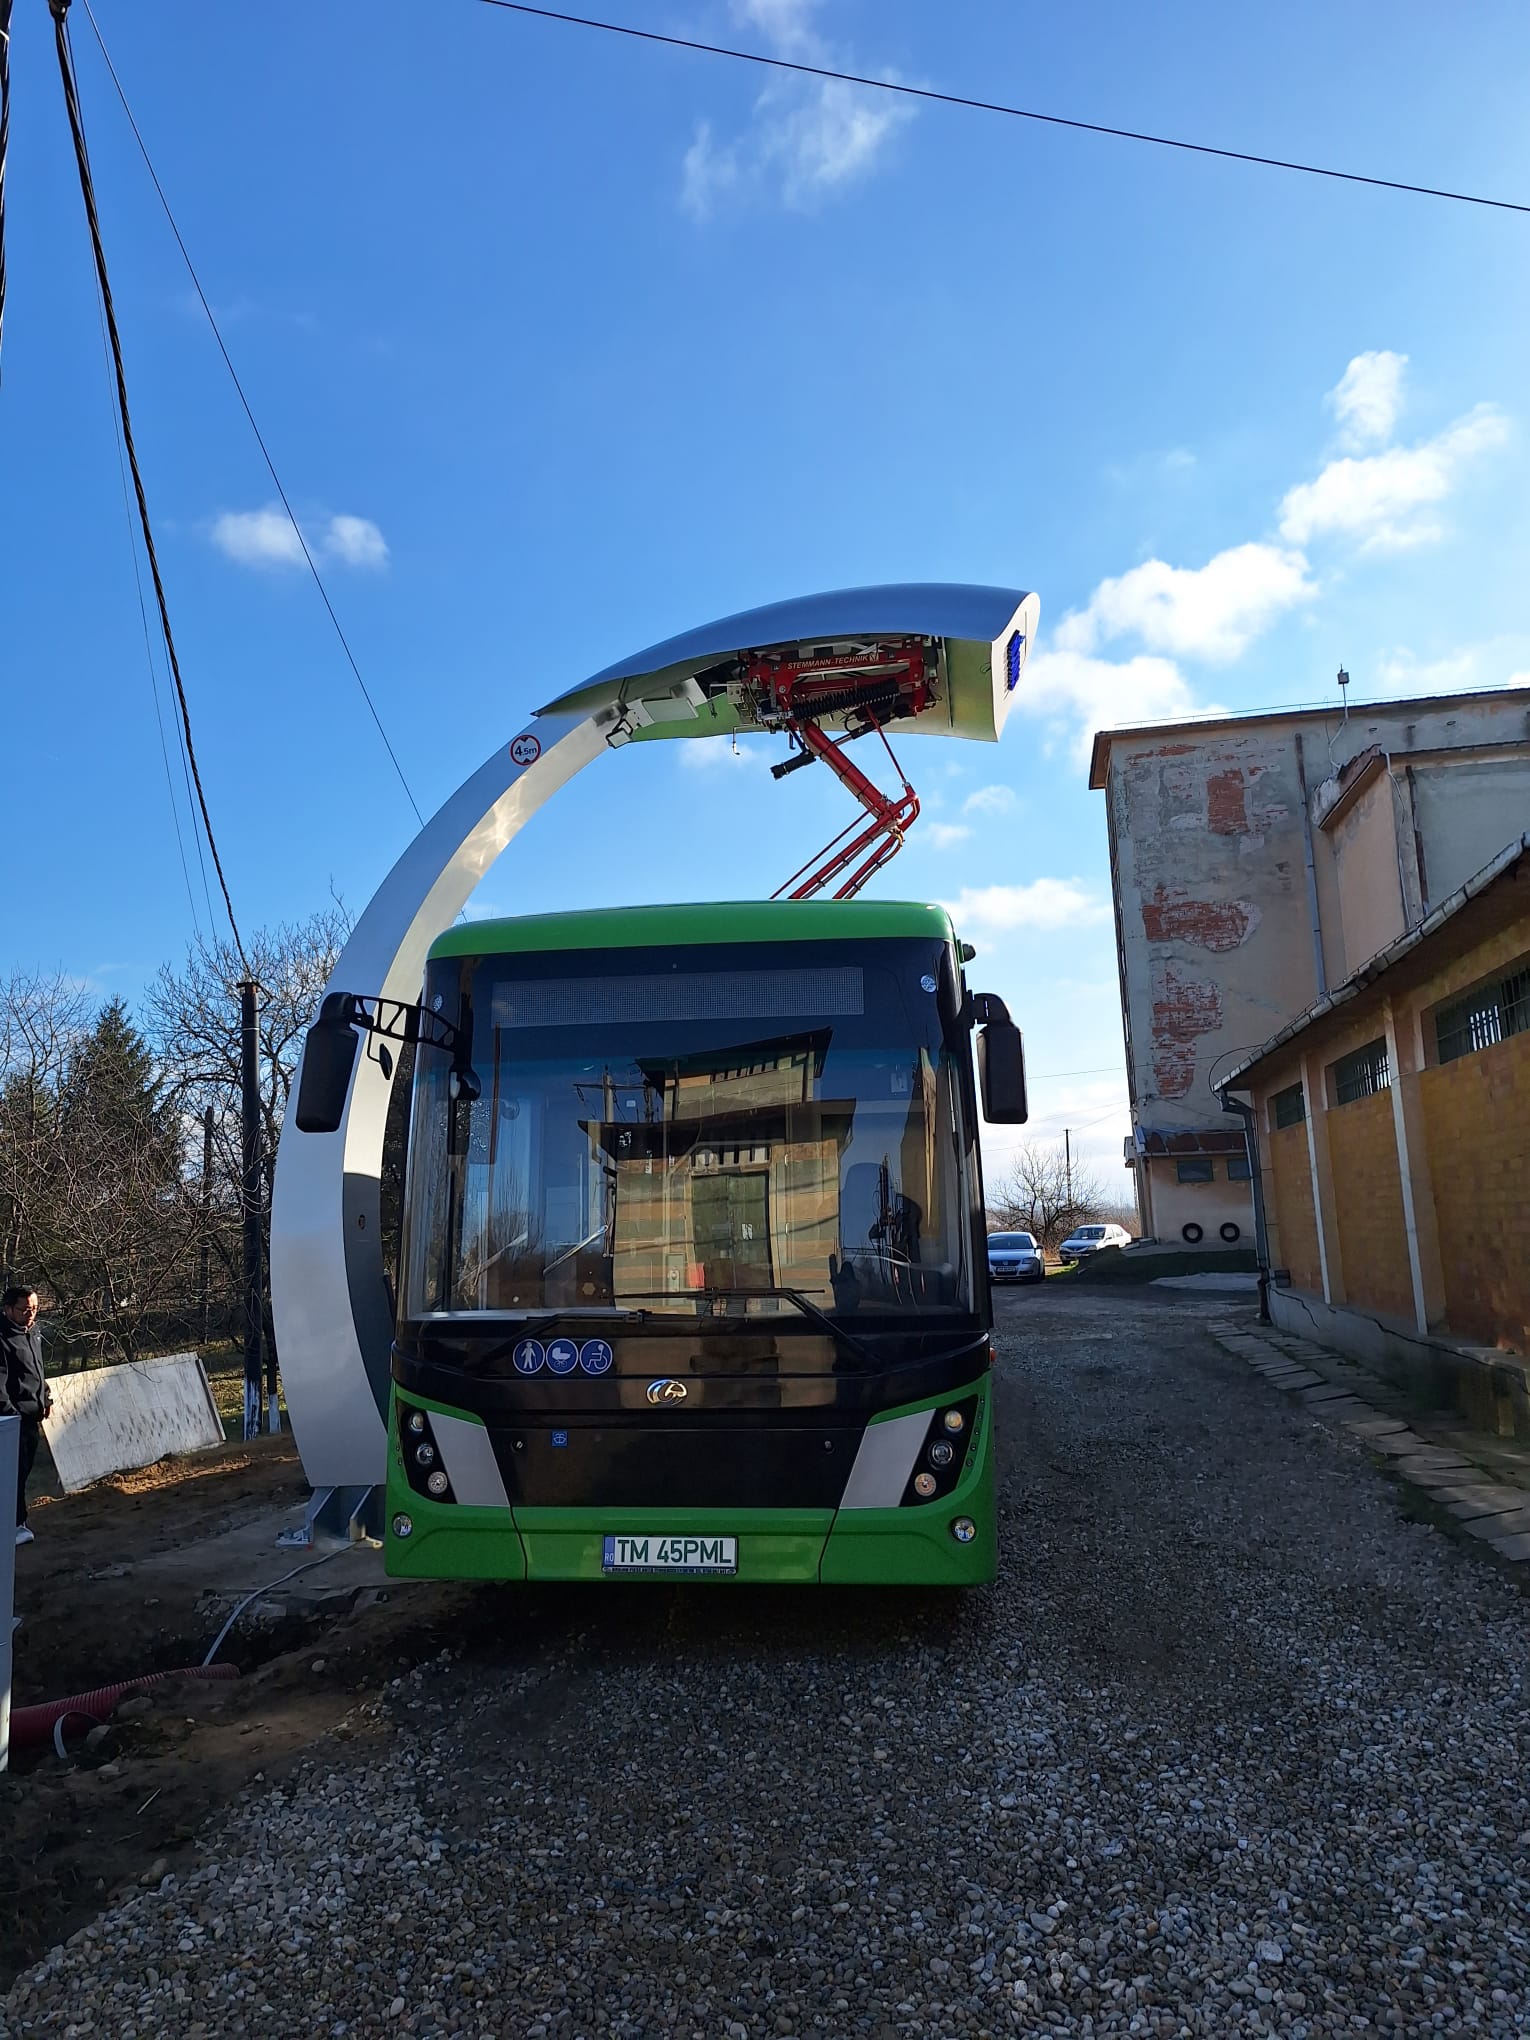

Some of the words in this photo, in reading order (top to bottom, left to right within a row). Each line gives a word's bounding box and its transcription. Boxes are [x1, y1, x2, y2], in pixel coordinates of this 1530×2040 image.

[605, 1553, 614, 1562] RO
[618, 1539, 649, 1563] TM
[656, 1540, 732, 1564] 45PML
